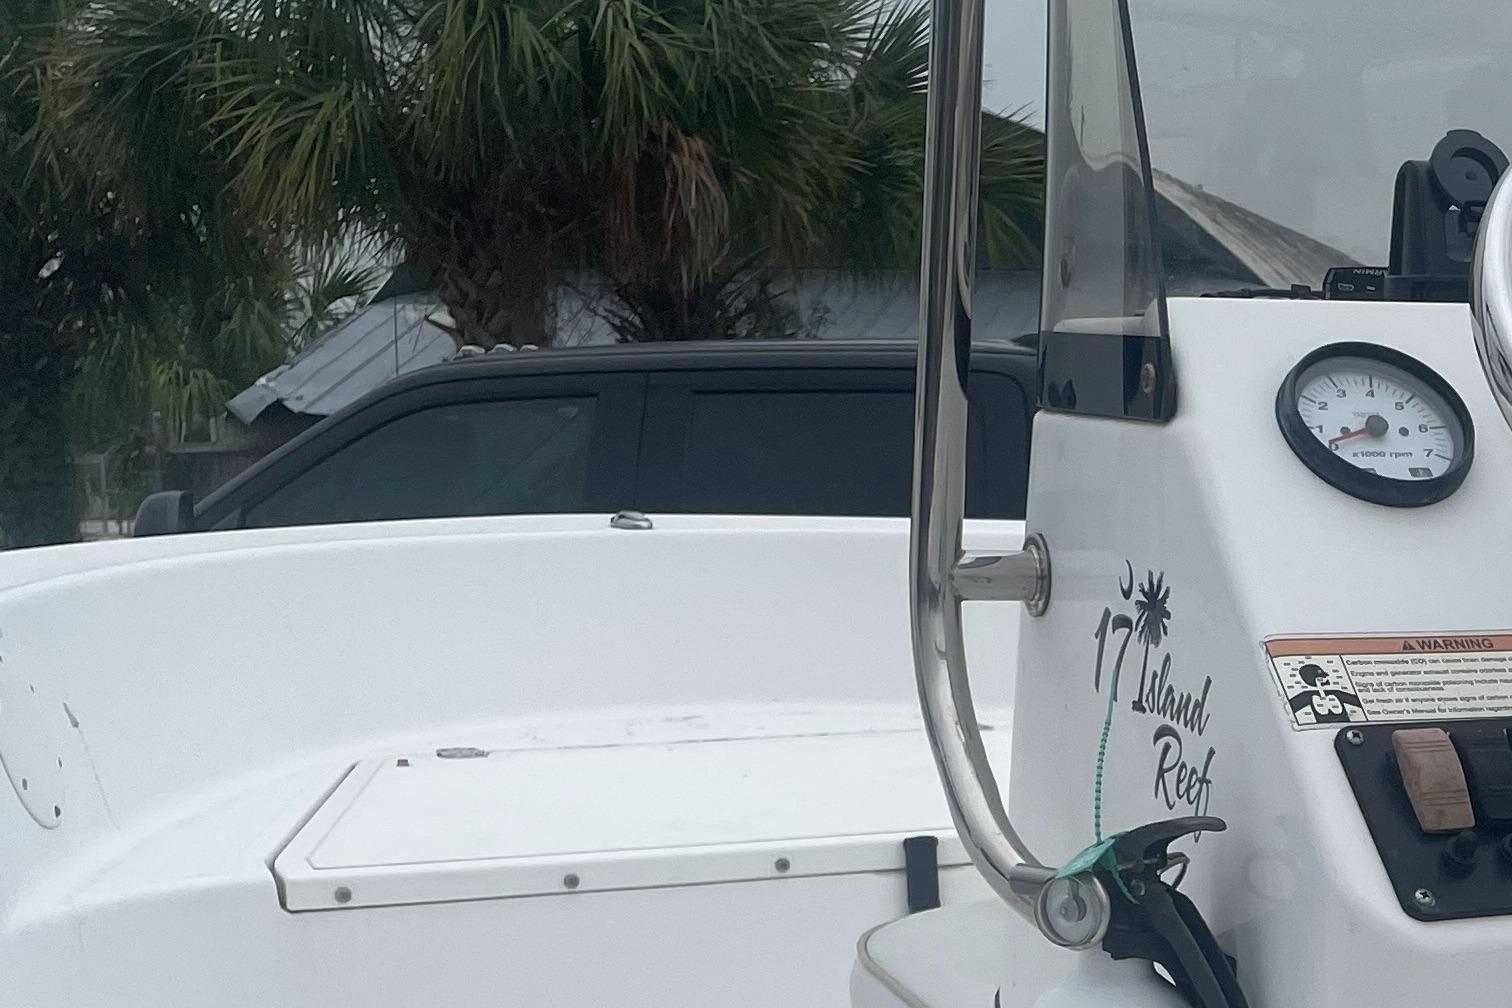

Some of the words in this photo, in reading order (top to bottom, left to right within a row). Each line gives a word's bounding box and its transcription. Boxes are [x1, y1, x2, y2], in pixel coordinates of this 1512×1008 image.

[1336, 389, 1347, 399] 3
[1365, 389, 1375, 398] 4
[1318, 402, 1329, 411] 2
[1395, 402, 1405, 411] 5
[1418, 424, 1429, 433] 6
[1389, 451, 1413, 459] rpm
[1424, 449, 1434, 458] 7
[1416, 638, 1494, 651] WARNING
[1094, 606, 1134, 702] 17
[1132, 648, 1213, 737] Island
[1153, 723, 1216, 838] Reef
